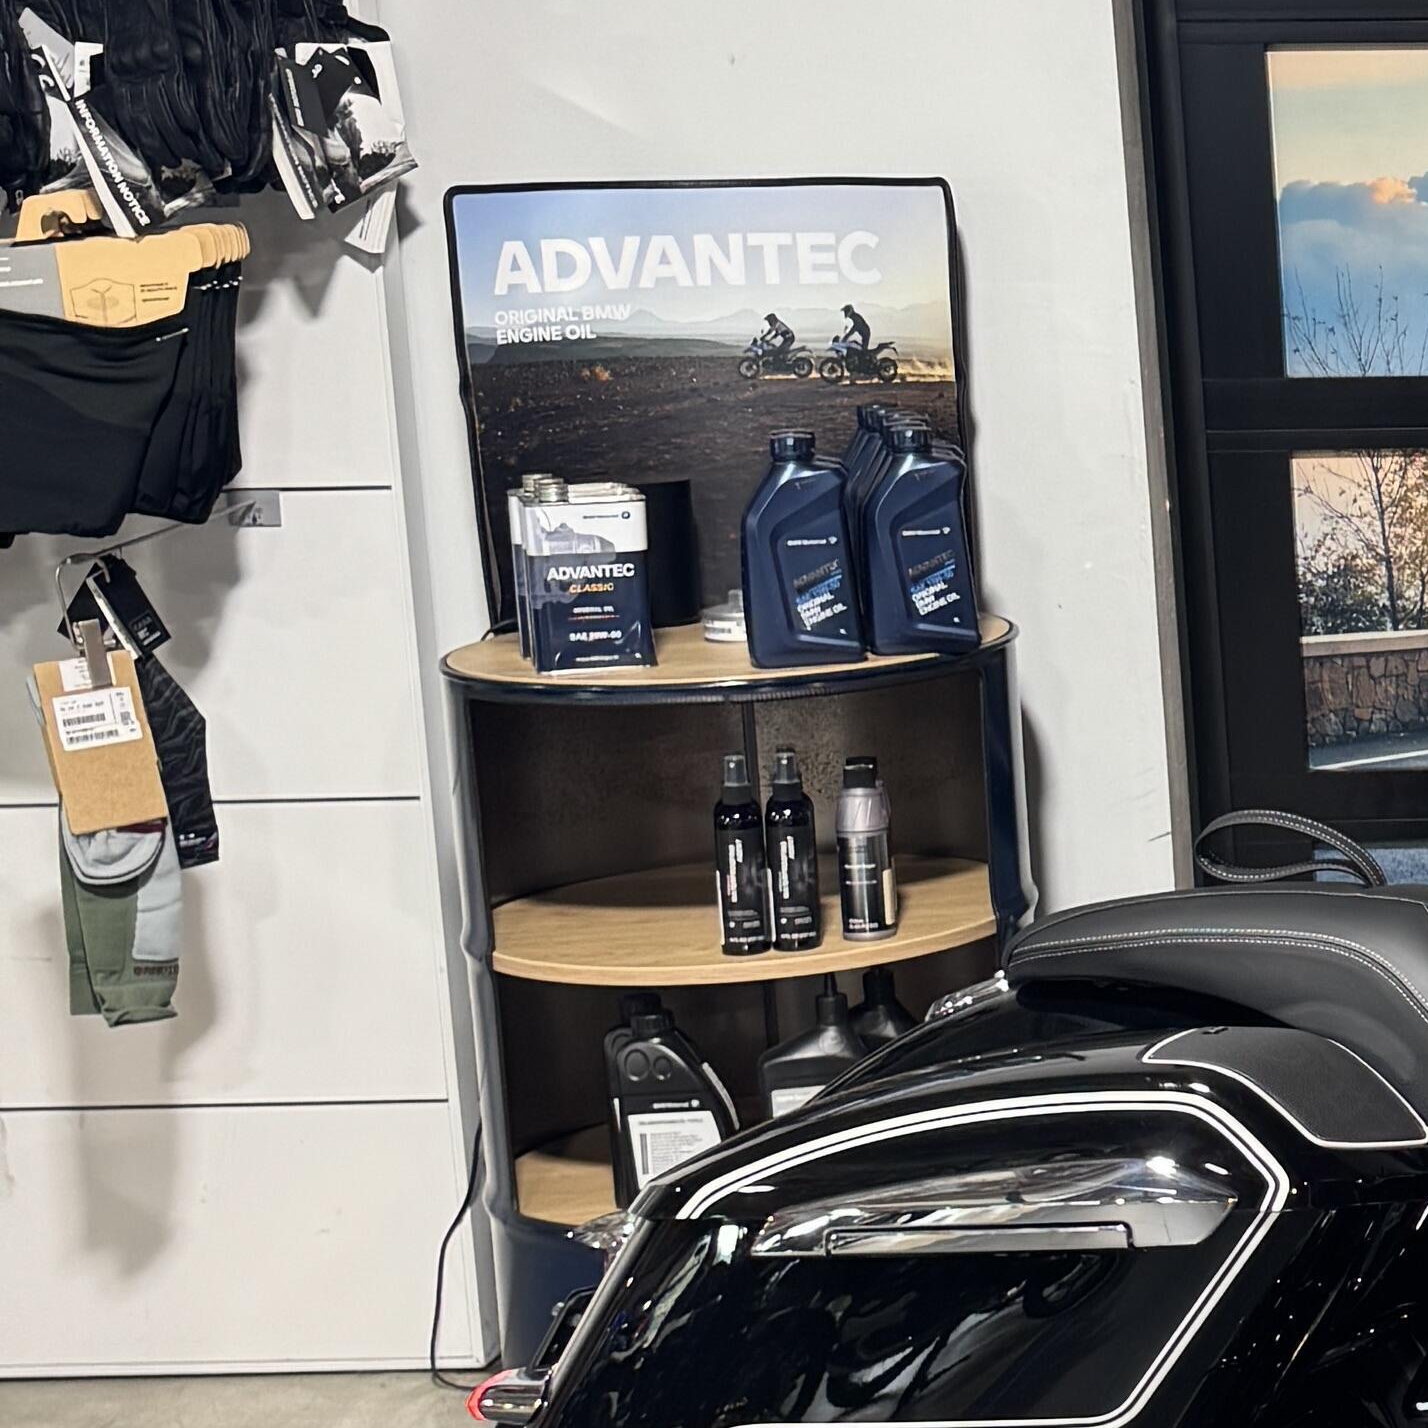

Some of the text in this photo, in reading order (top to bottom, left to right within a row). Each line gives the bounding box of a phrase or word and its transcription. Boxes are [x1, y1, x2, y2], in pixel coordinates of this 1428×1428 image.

[75, 99, 151, 226] INFORMATION NOTICE
[494, 230, 883, 296] ADVANTEC
[494, 303, 631, 326] ORIGINAL BMW
[496, 323, 597, 346] ENGINE OIL
[546, 563, 635, 582] ADVANTEC
[568, 582, 614, 594] CLASSIC
